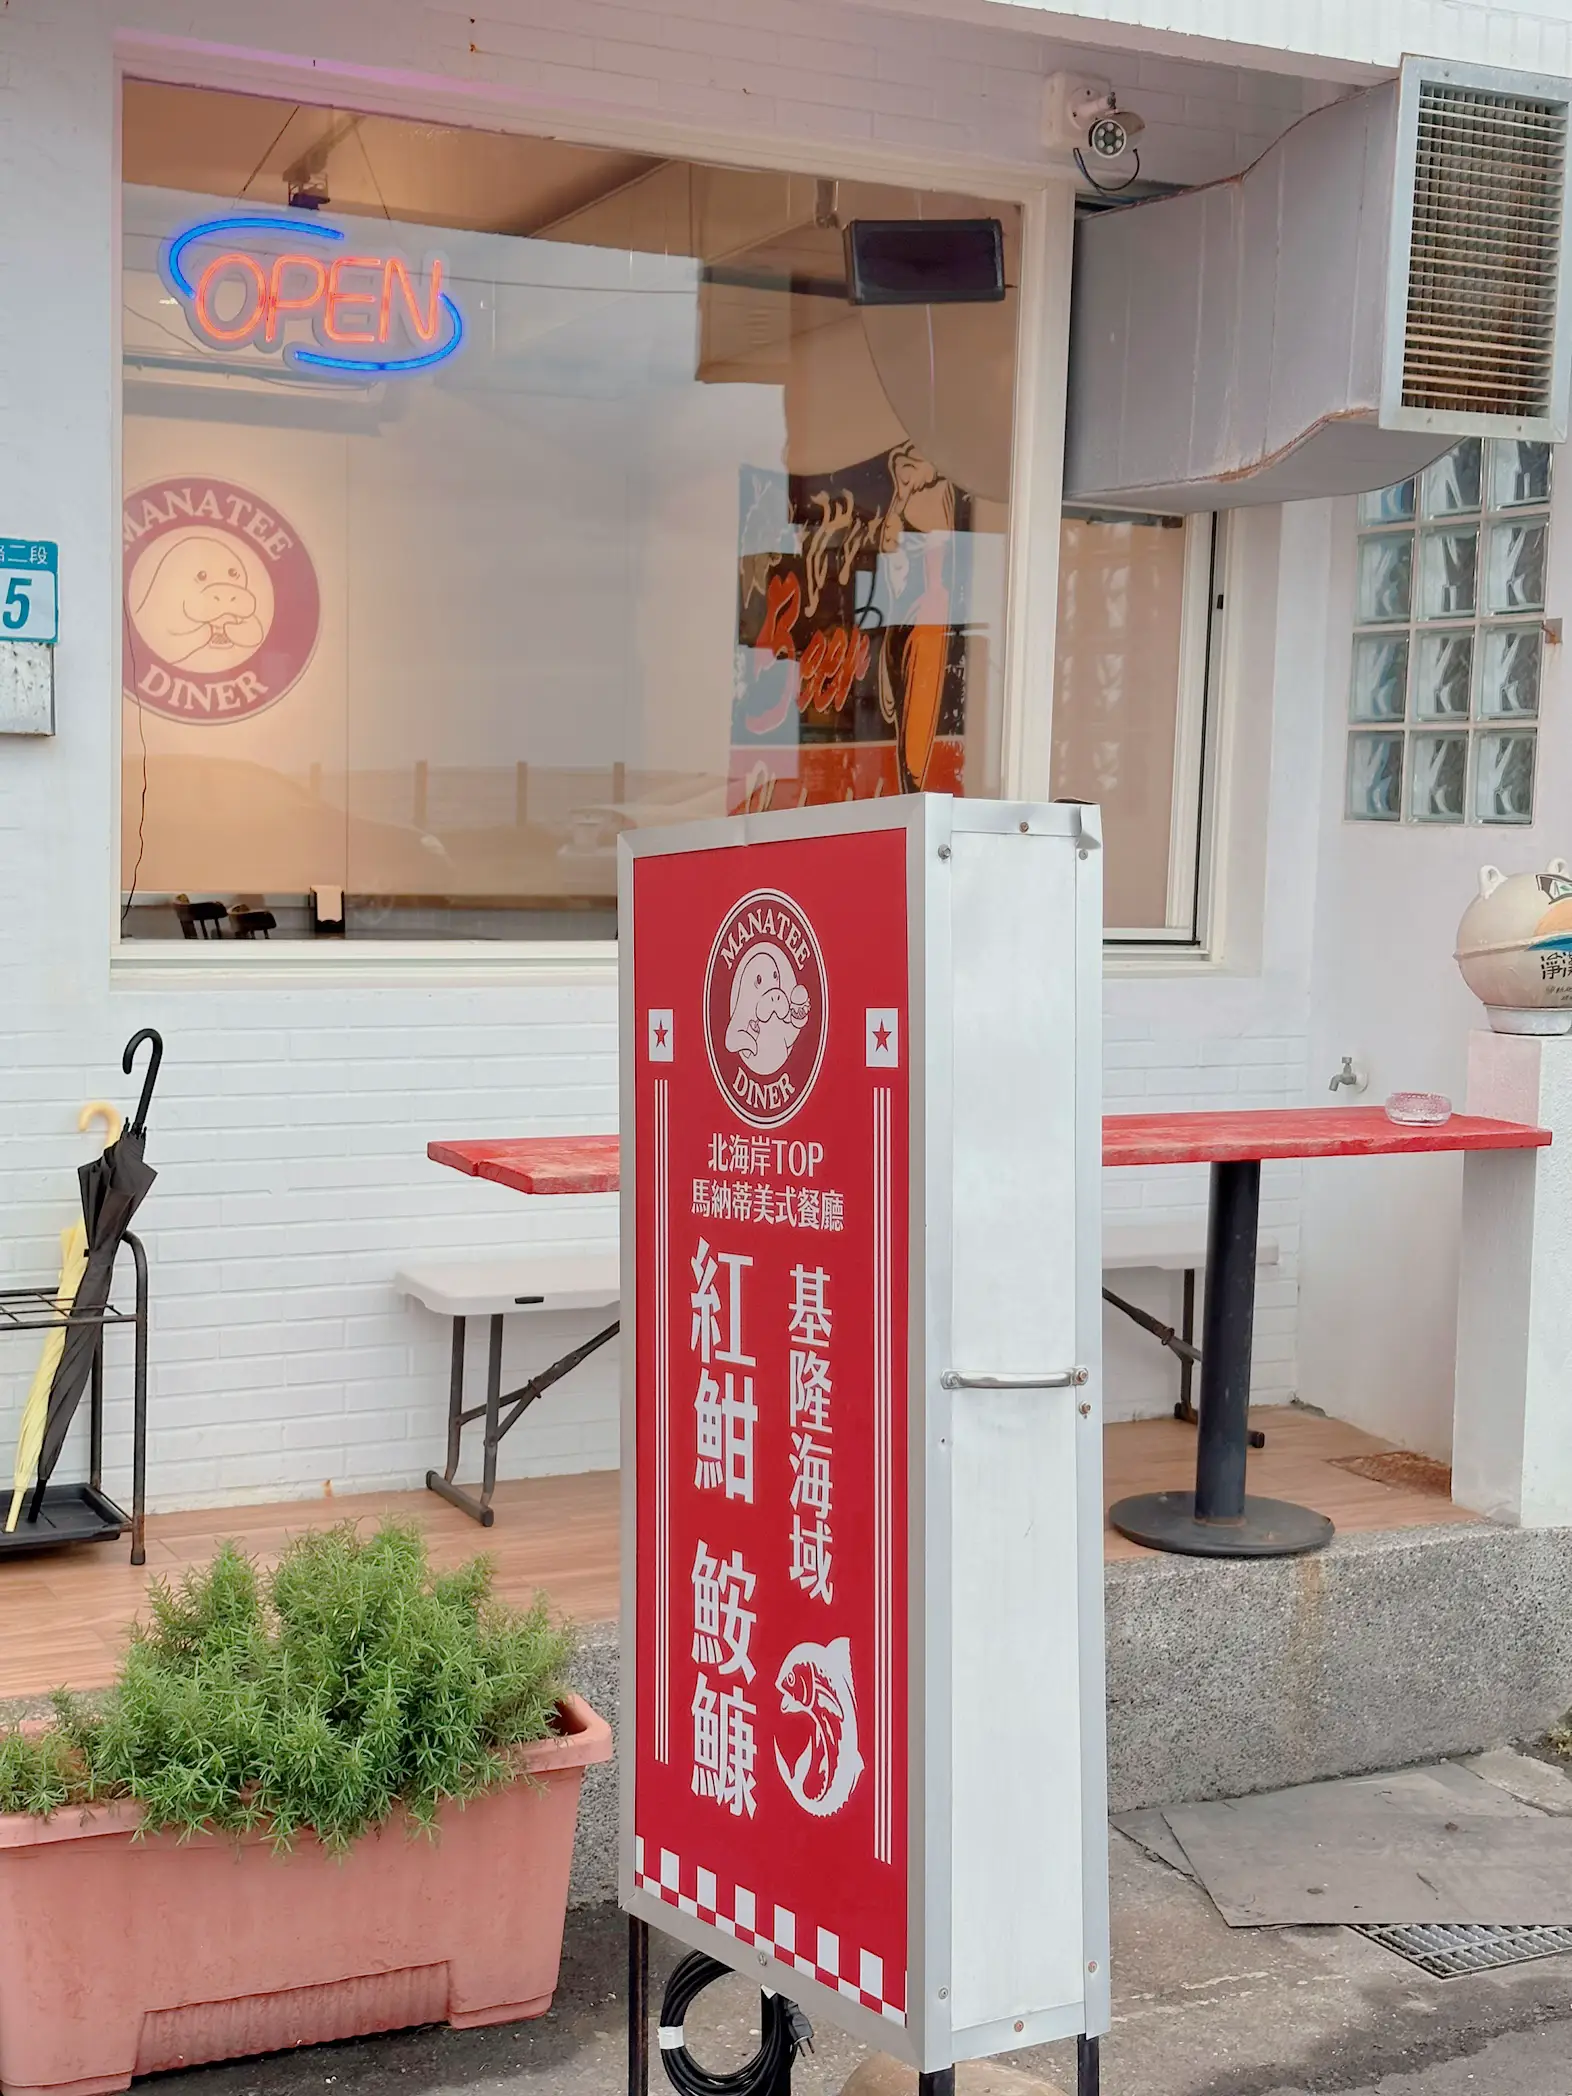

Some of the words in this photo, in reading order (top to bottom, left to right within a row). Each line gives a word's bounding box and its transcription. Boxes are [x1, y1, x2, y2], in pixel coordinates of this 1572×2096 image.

[196, 254, 442, 343] OPEN
[138, 664, 269, 712] DINER
[720, 908, 811, 971] MANATEE
[732, 1068, 796, 1110] DINER
[691, 1178, 845, 1231] 馬納蒂美式餐廳
[788, 1263, 834, 1605] 基隆海域
